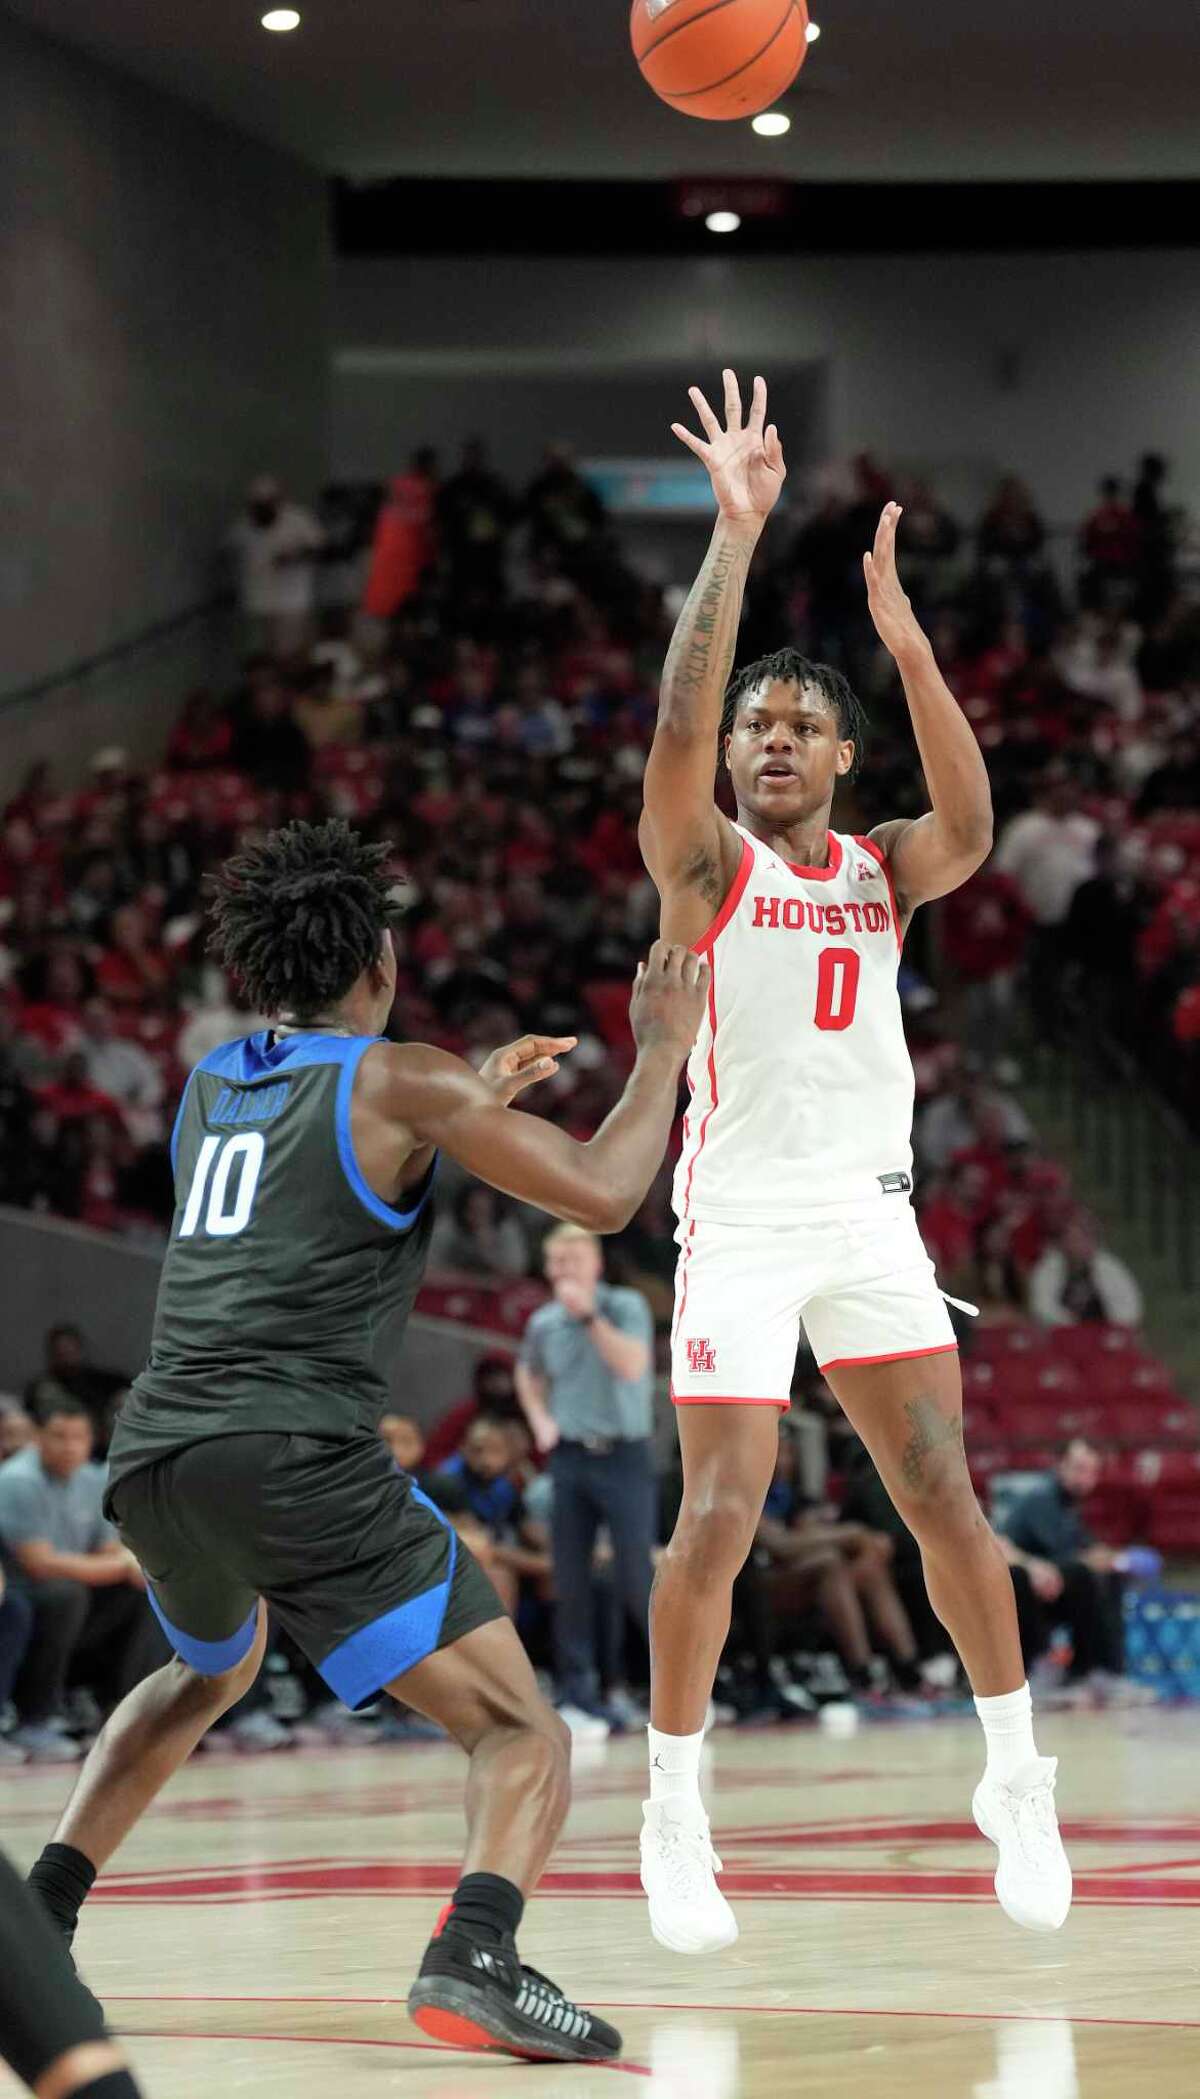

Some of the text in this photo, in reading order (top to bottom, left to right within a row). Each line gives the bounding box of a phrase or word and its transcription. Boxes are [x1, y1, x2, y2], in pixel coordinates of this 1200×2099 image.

[752, 896, 891, 936] HOUSTON
[814, 947, 860, 1031] 0
[179, 1131, 265, 1237] 10
